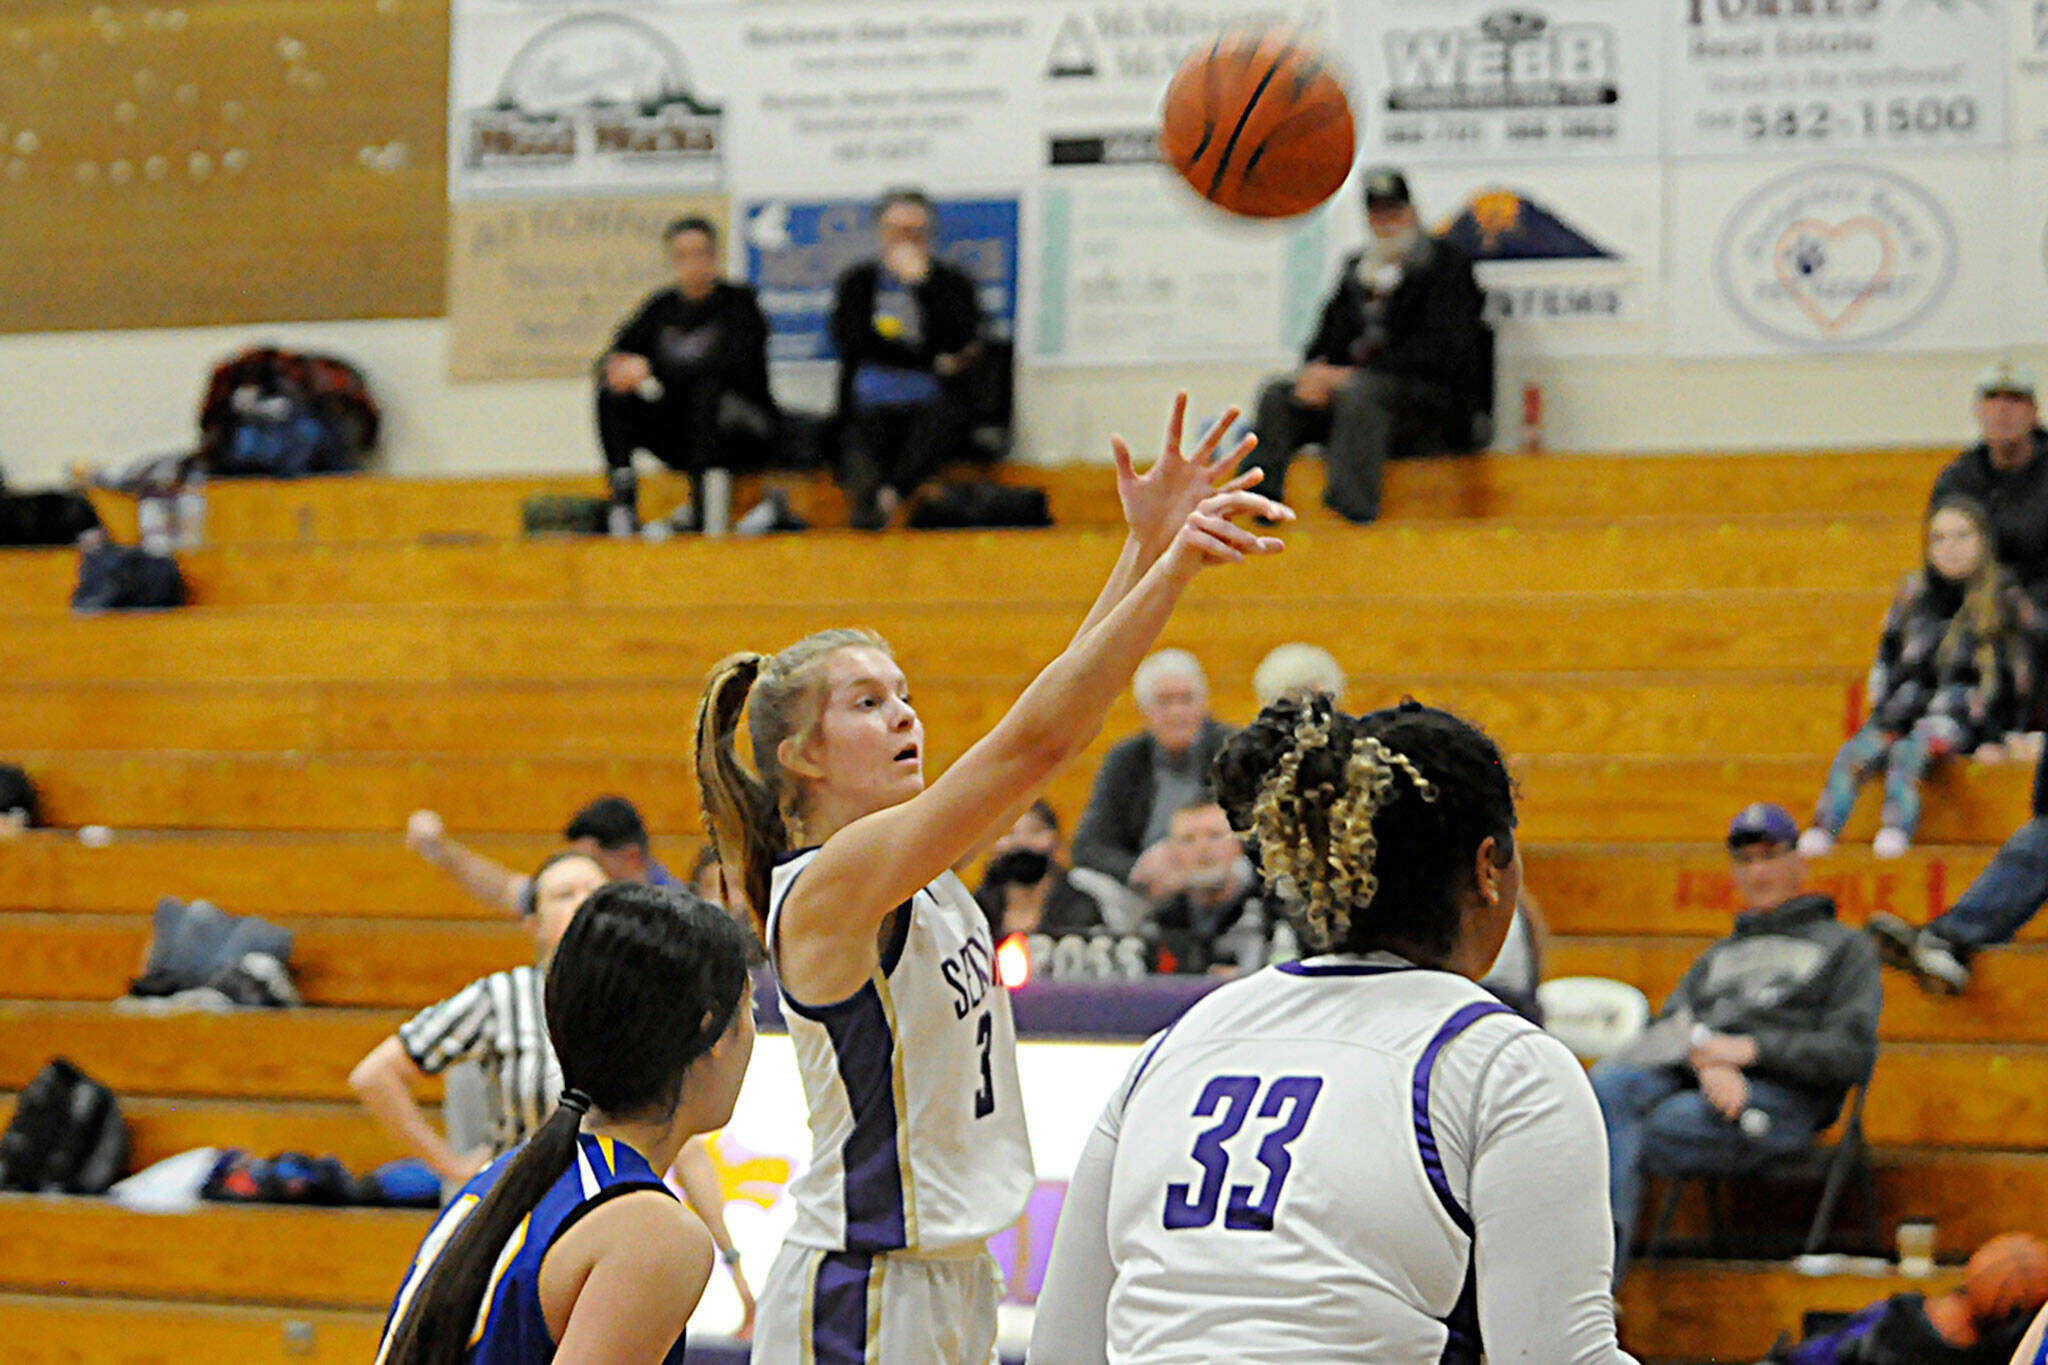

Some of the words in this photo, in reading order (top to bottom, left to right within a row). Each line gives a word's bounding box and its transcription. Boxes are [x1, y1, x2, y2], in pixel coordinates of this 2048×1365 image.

[1384, 24, 1616, 84] WEBB
[1743, 97, 1979, 143] 582-1500
[974, 1010, 996, 1120] 3
[1162, 1075, 1324, 1232] 33
